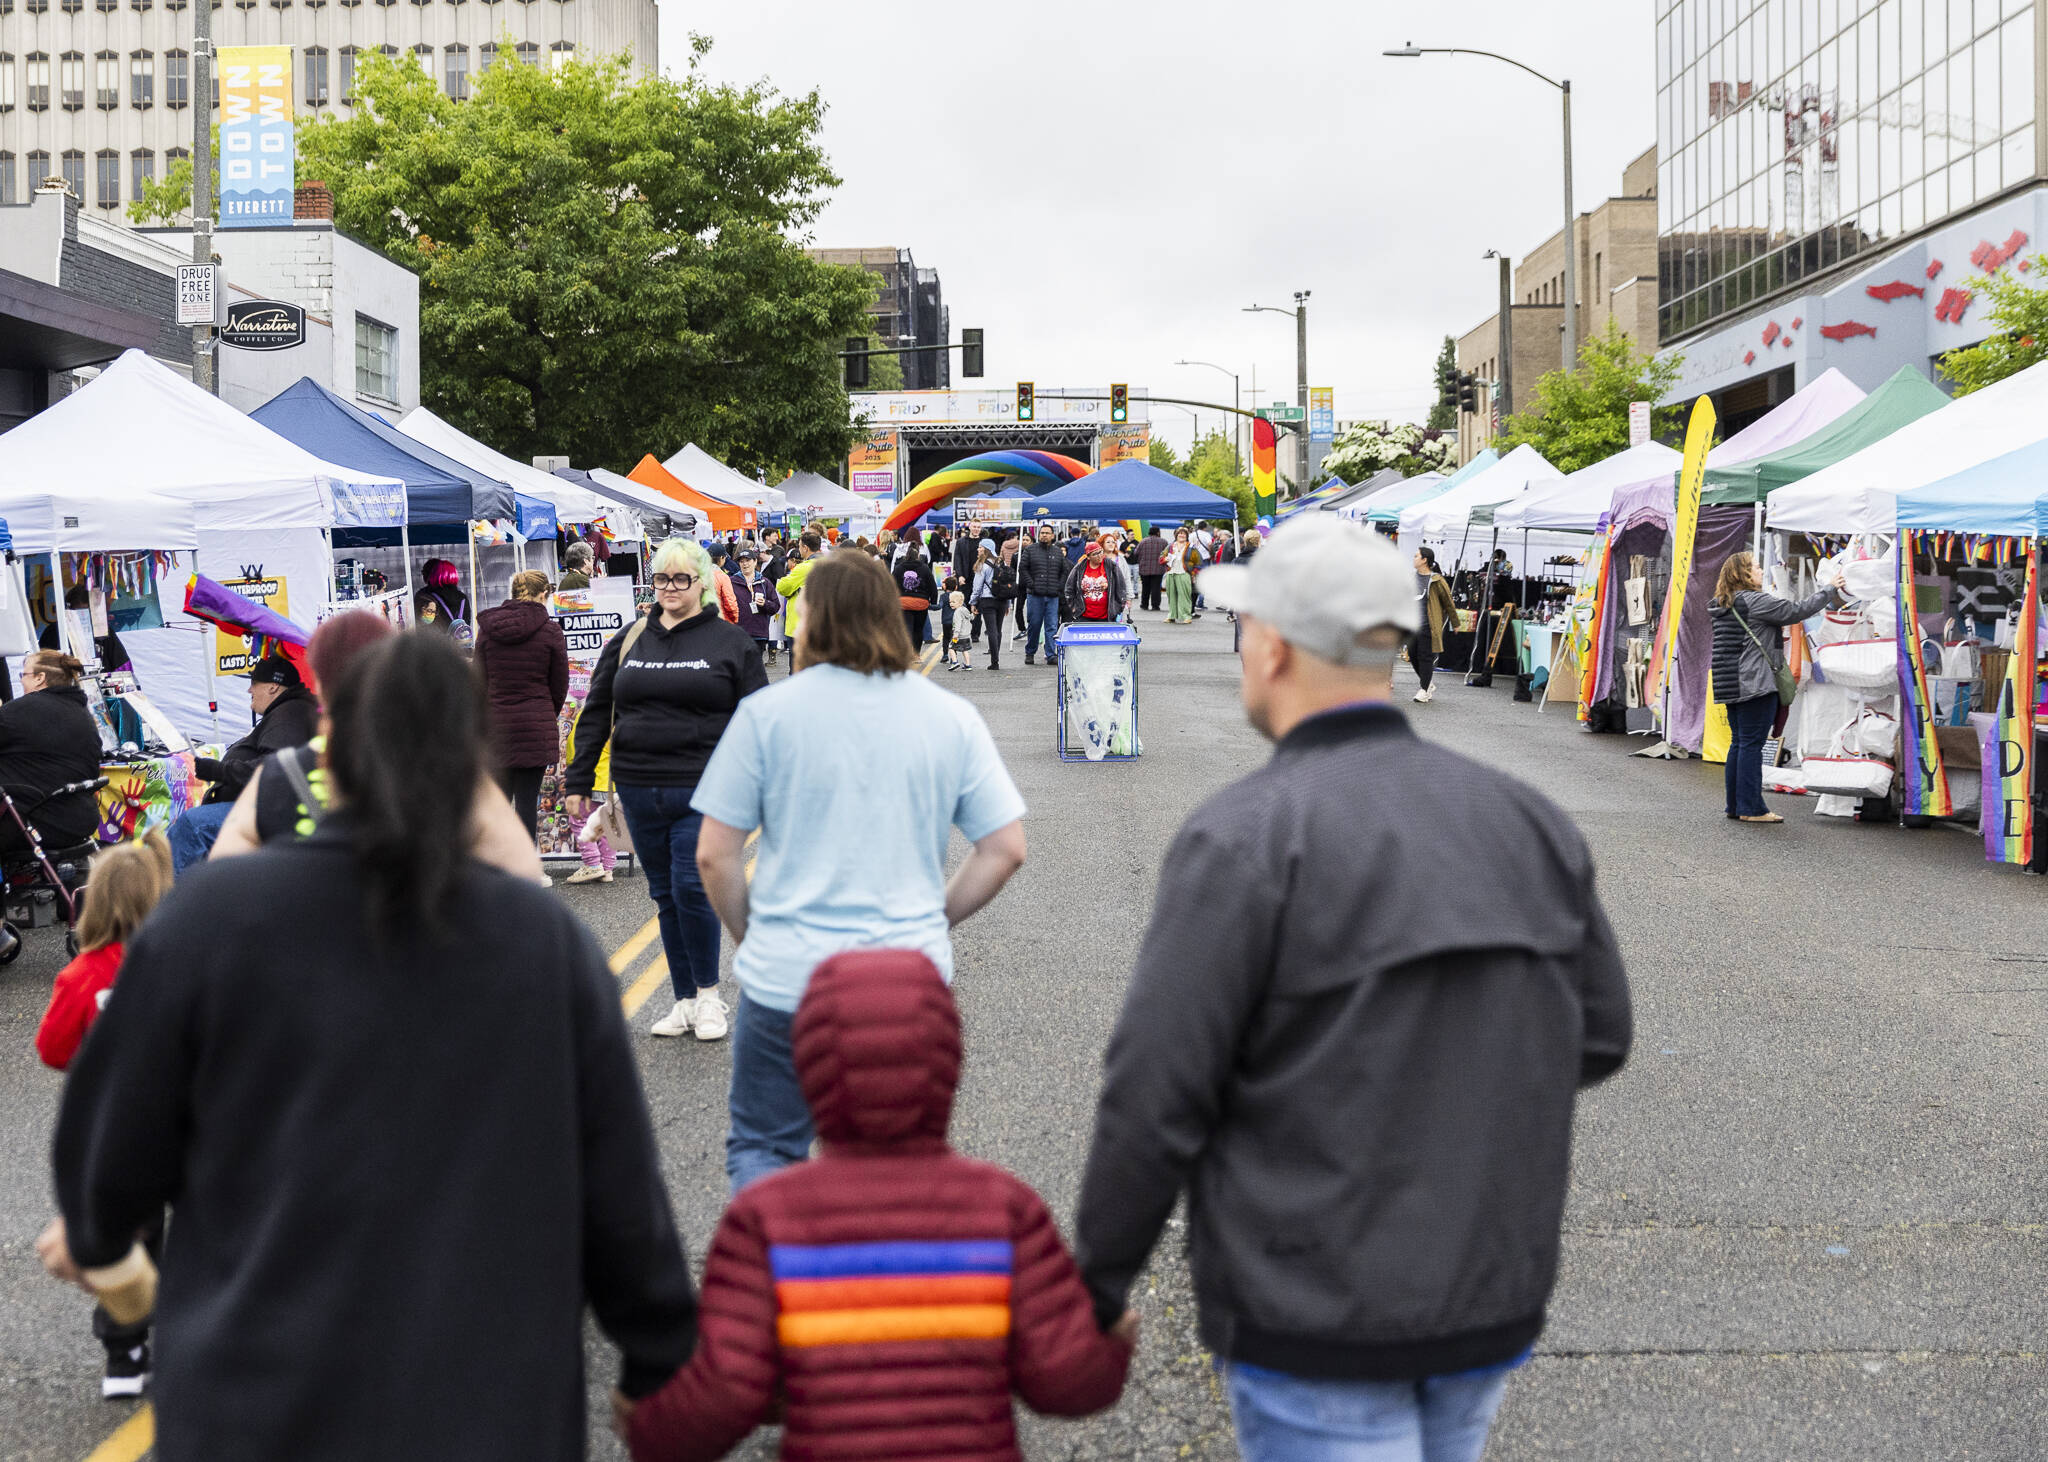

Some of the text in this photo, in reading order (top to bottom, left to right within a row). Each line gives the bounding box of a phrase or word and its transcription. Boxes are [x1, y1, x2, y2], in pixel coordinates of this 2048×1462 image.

[225, 65, 252, 180] DOWN
[258, 64, 285, 180] TOWN
[228, 200, 285, 214] EVERETT
[181, 267, 211, 279] DRUG
[182, 280, 210, 291] FREE
[182, 293, 210, 303] ZONE
[222, 309, 297, 332] Narrative
[1265, 409, 1286, 419] Wall
[865, 441, 894, 453] Pride
[1118, 438, 1147, 450] Pride
[957, 509, 1020, 520] EVERETT
[563, 614, 619, 630] PAINTING
[564, 634, 601, 649] ENU
[221, 656, 246, 669] LASTS
[624, 658, 710, 670] you are enough.
[1898, 546, 1939, 793] HAPPY
